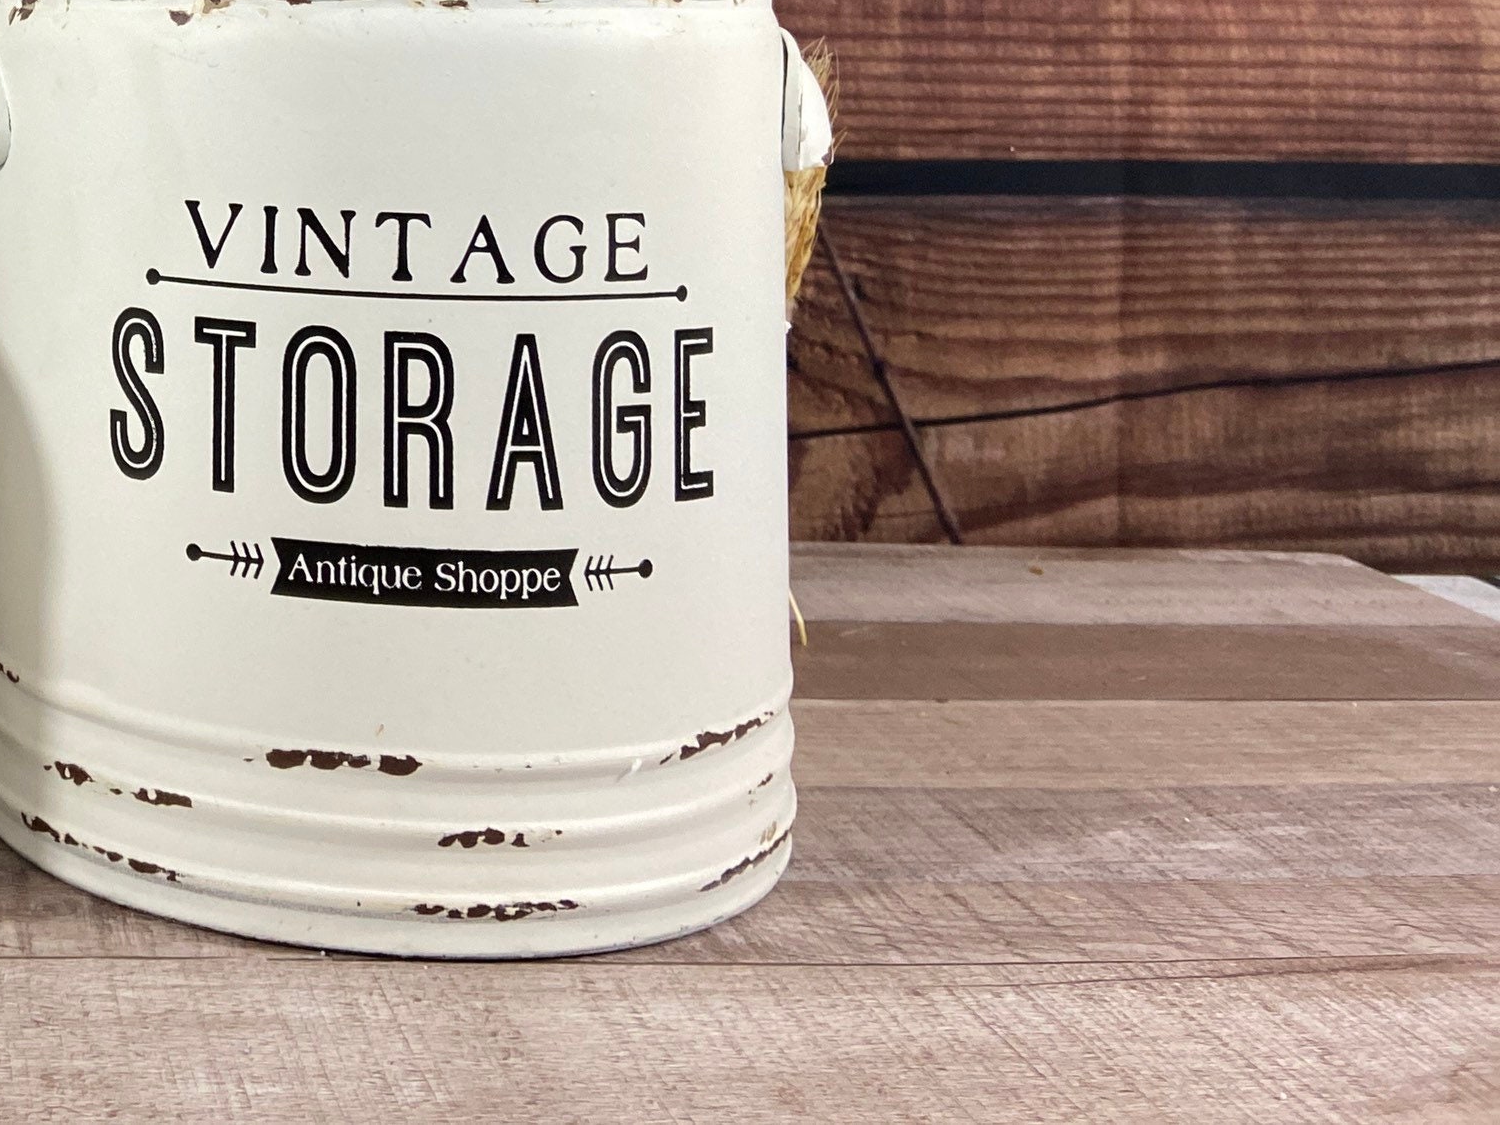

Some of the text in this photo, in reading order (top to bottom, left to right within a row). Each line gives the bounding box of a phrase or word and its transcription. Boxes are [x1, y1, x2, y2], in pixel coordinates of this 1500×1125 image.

[184, 199, 649, 285] VINTAGE
[109, 306, 715, 511] STORAGE
[286, 553, 562, 599] Antique Shoppe
